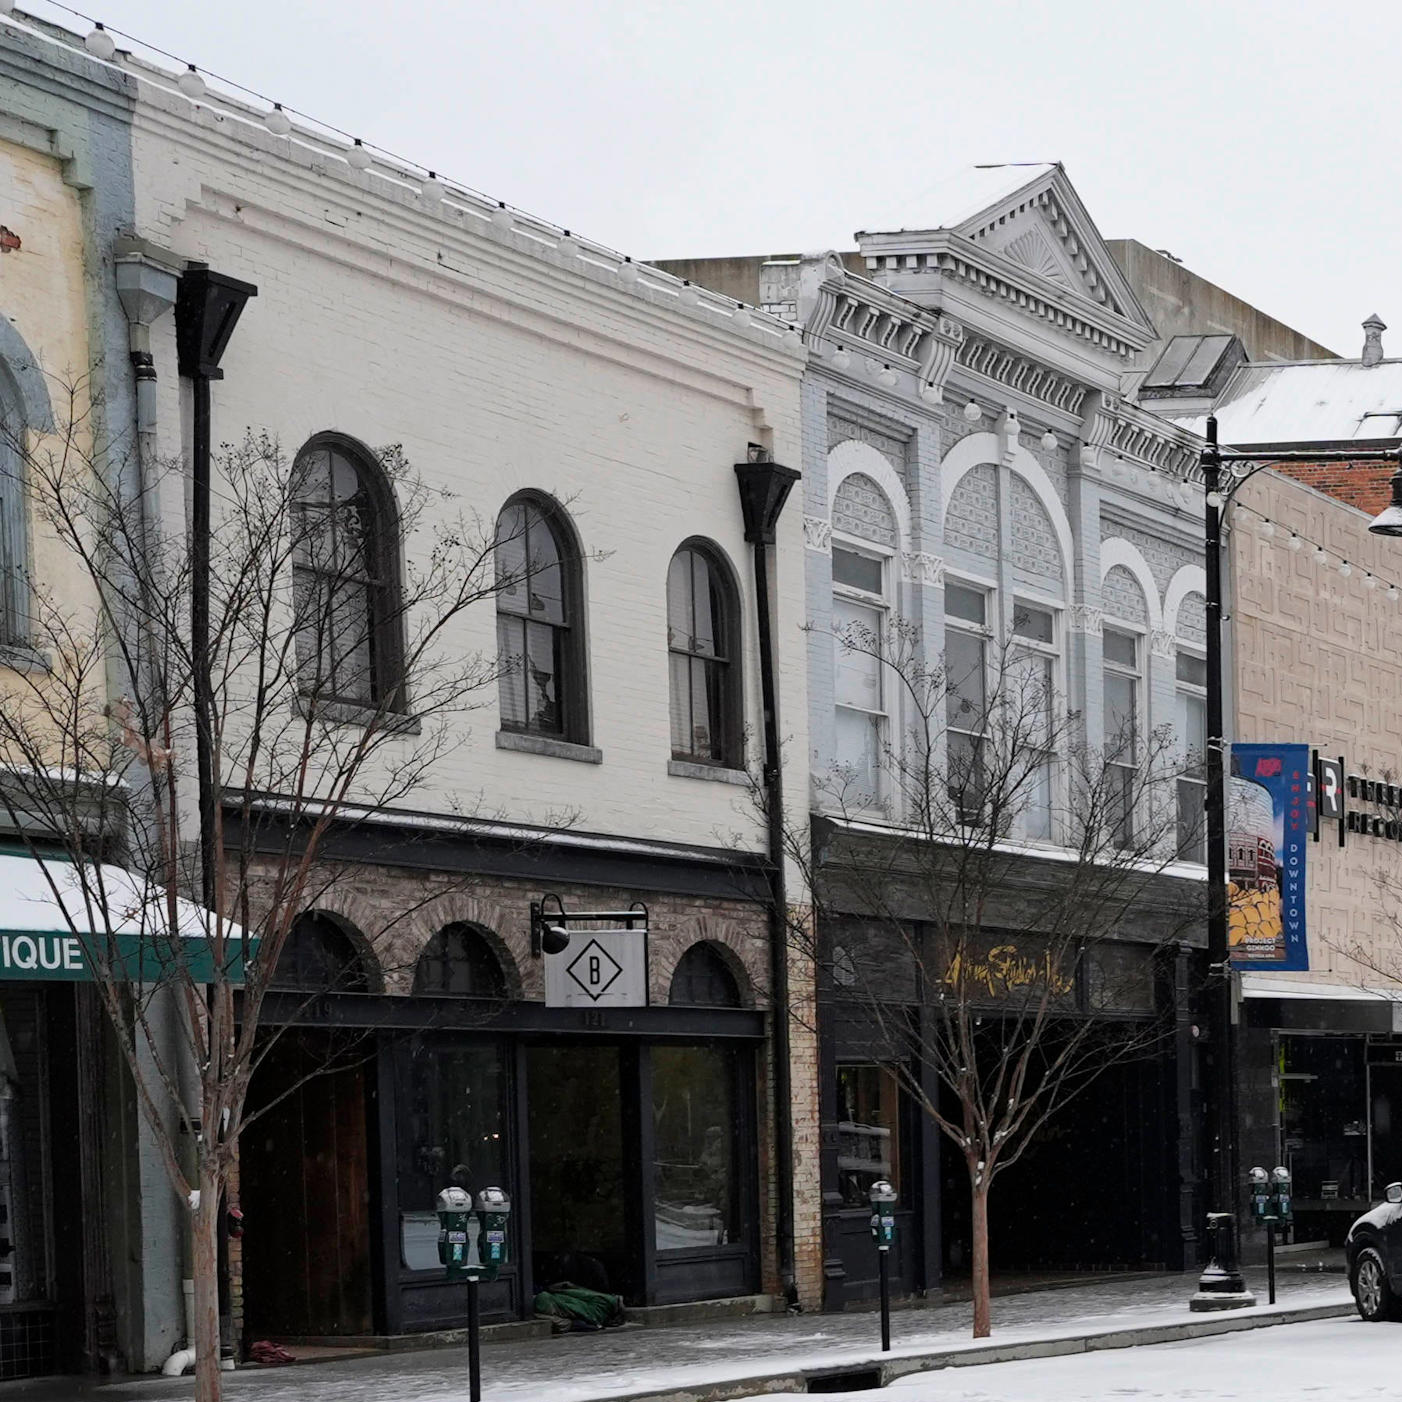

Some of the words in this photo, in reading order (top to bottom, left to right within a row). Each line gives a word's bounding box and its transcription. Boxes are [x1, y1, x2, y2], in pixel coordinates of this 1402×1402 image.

[1289, 844, 1300, 943] DOWNTOWN
[2, 935, 84, 971] IQUE
[589, 956, 600, 985] B
